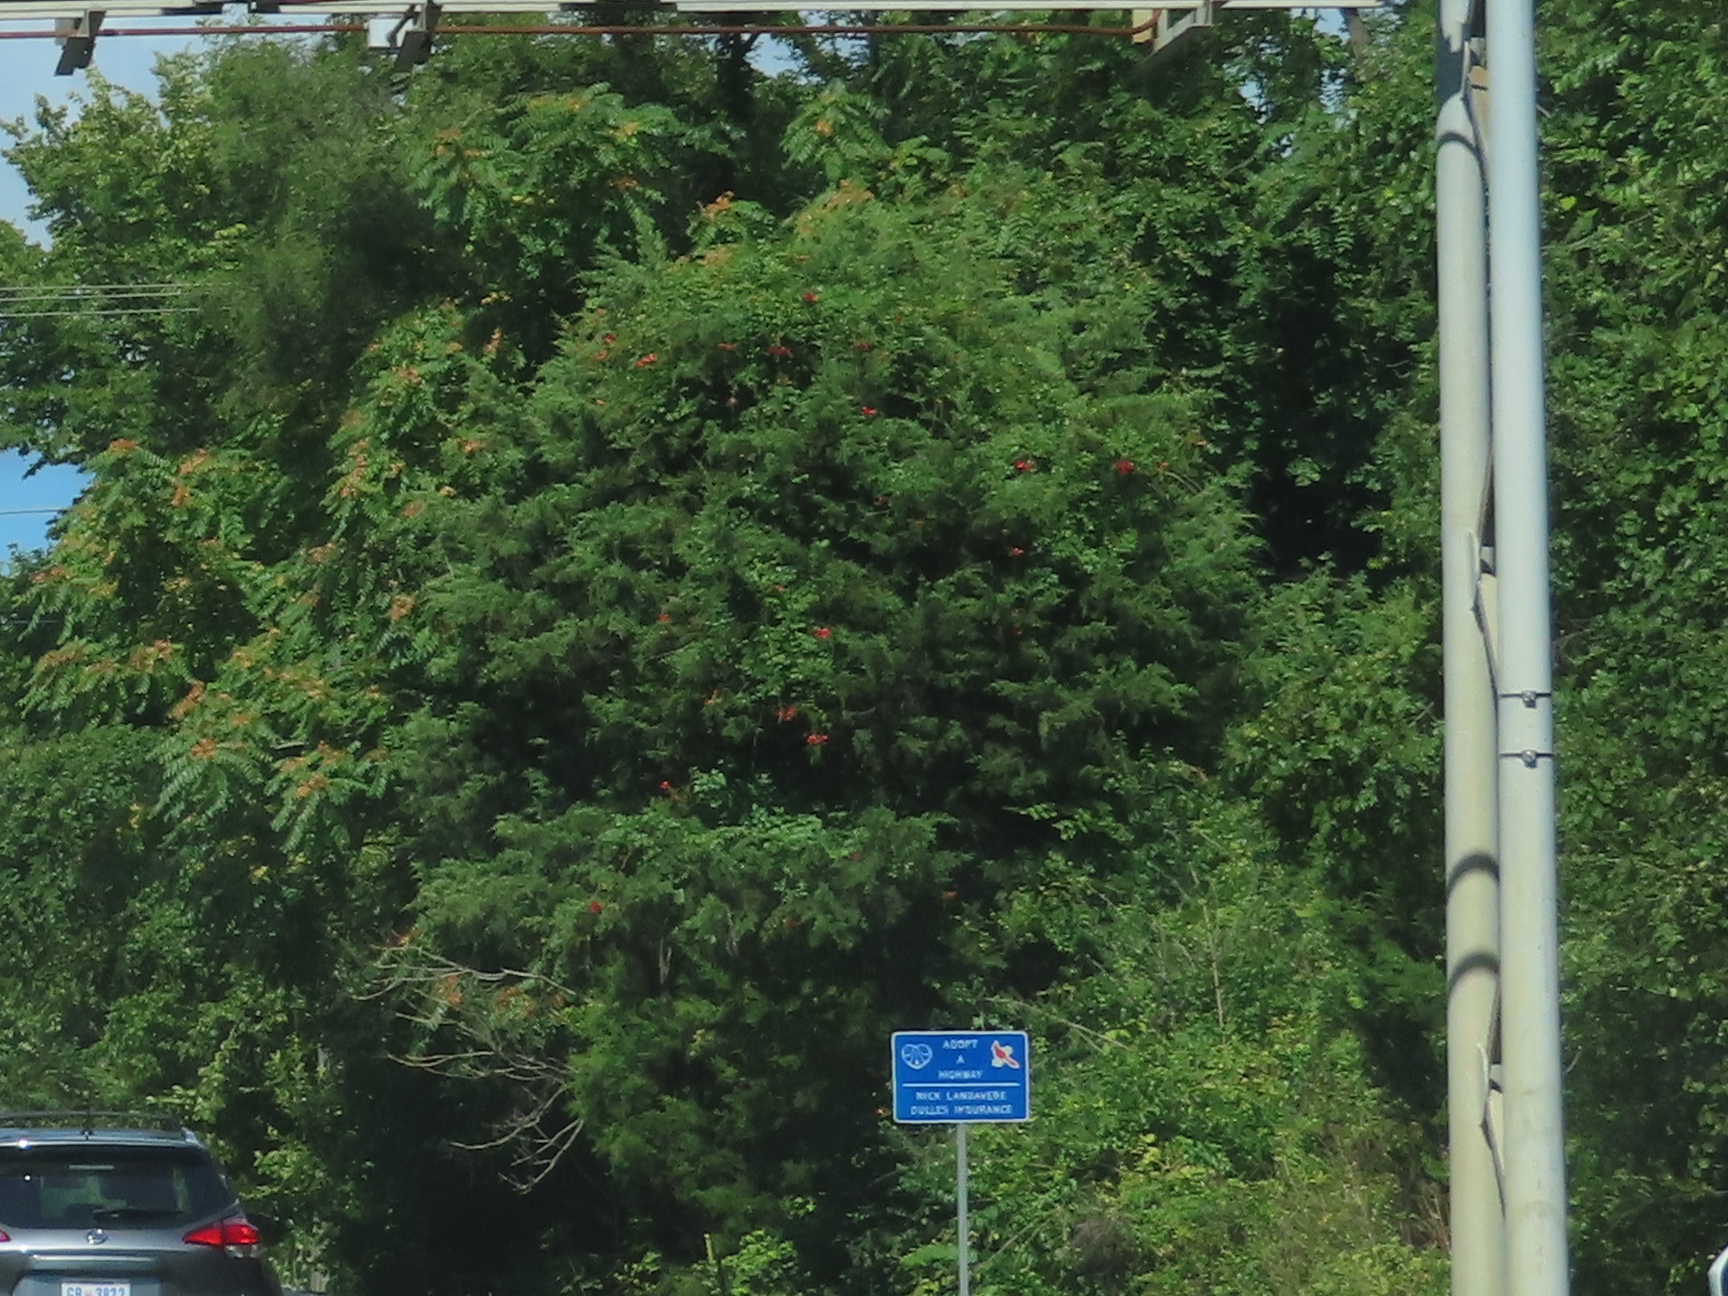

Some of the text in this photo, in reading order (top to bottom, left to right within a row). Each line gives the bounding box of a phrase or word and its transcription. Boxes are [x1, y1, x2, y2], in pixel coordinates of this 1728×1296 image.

[942, 1039, 979, 1049] ADOPT
[955, 1054, 965, 1064] A
[938, 1070, 983, 1080] HIGHWAY
[910, 1104, 1014, 1115] DULLES INSURANCE
